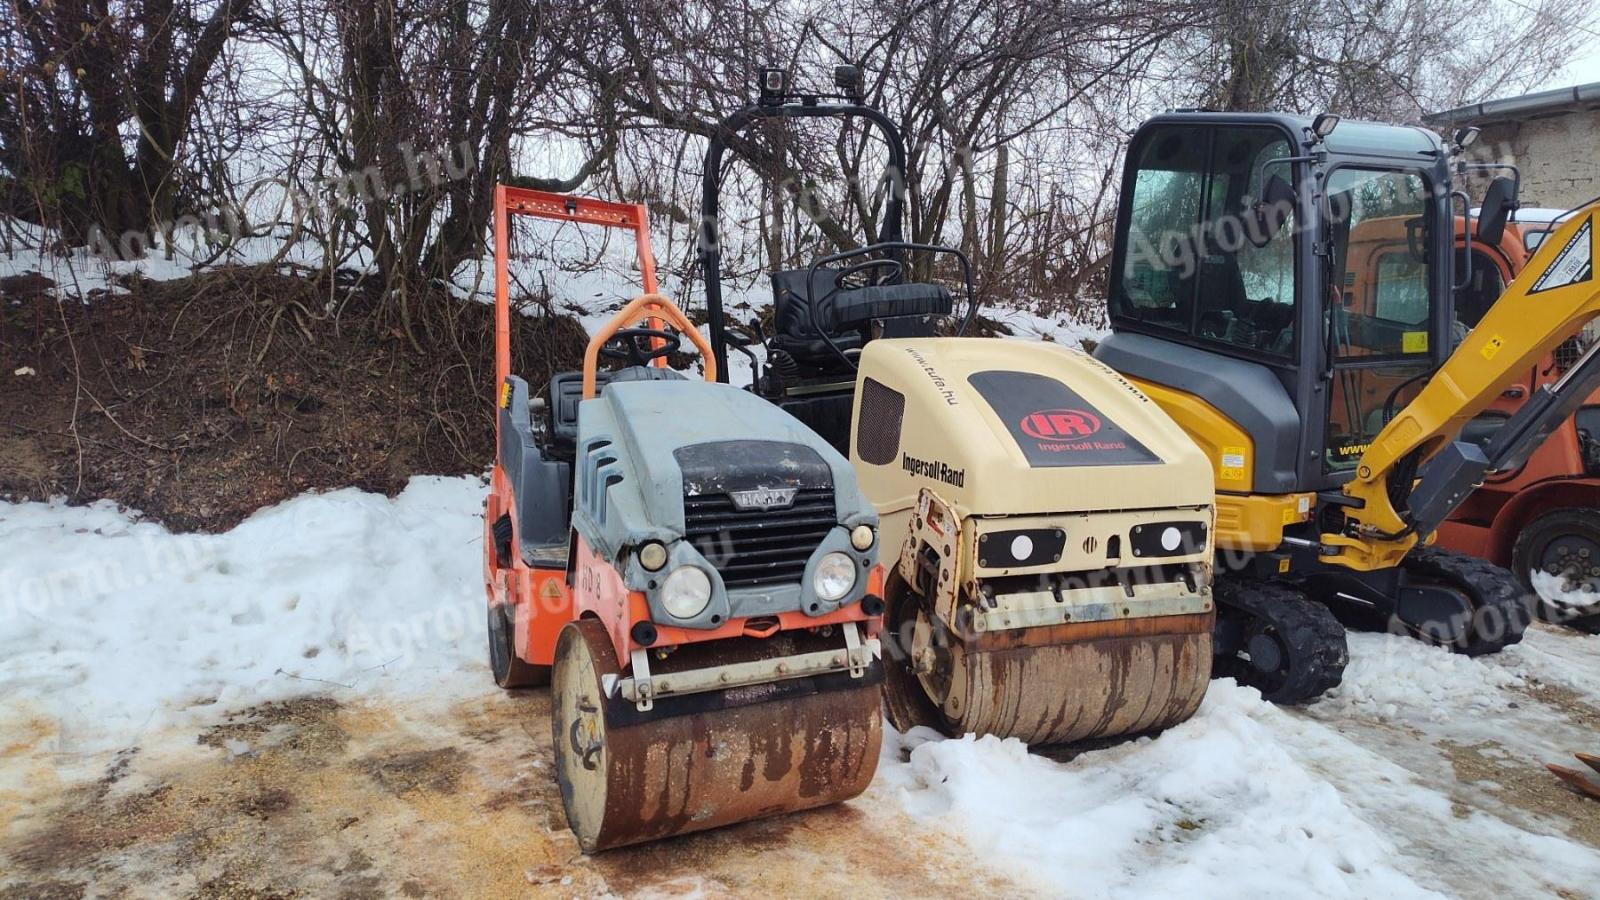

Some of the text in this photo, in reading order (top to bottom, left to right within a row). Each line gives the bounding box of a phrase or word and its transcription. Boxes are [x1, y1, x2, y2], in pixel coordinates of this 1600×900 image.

[905, 347, 959, 406] www.tufa.hu
[1038, 441, 1126, 452] Ingersoll Rand
